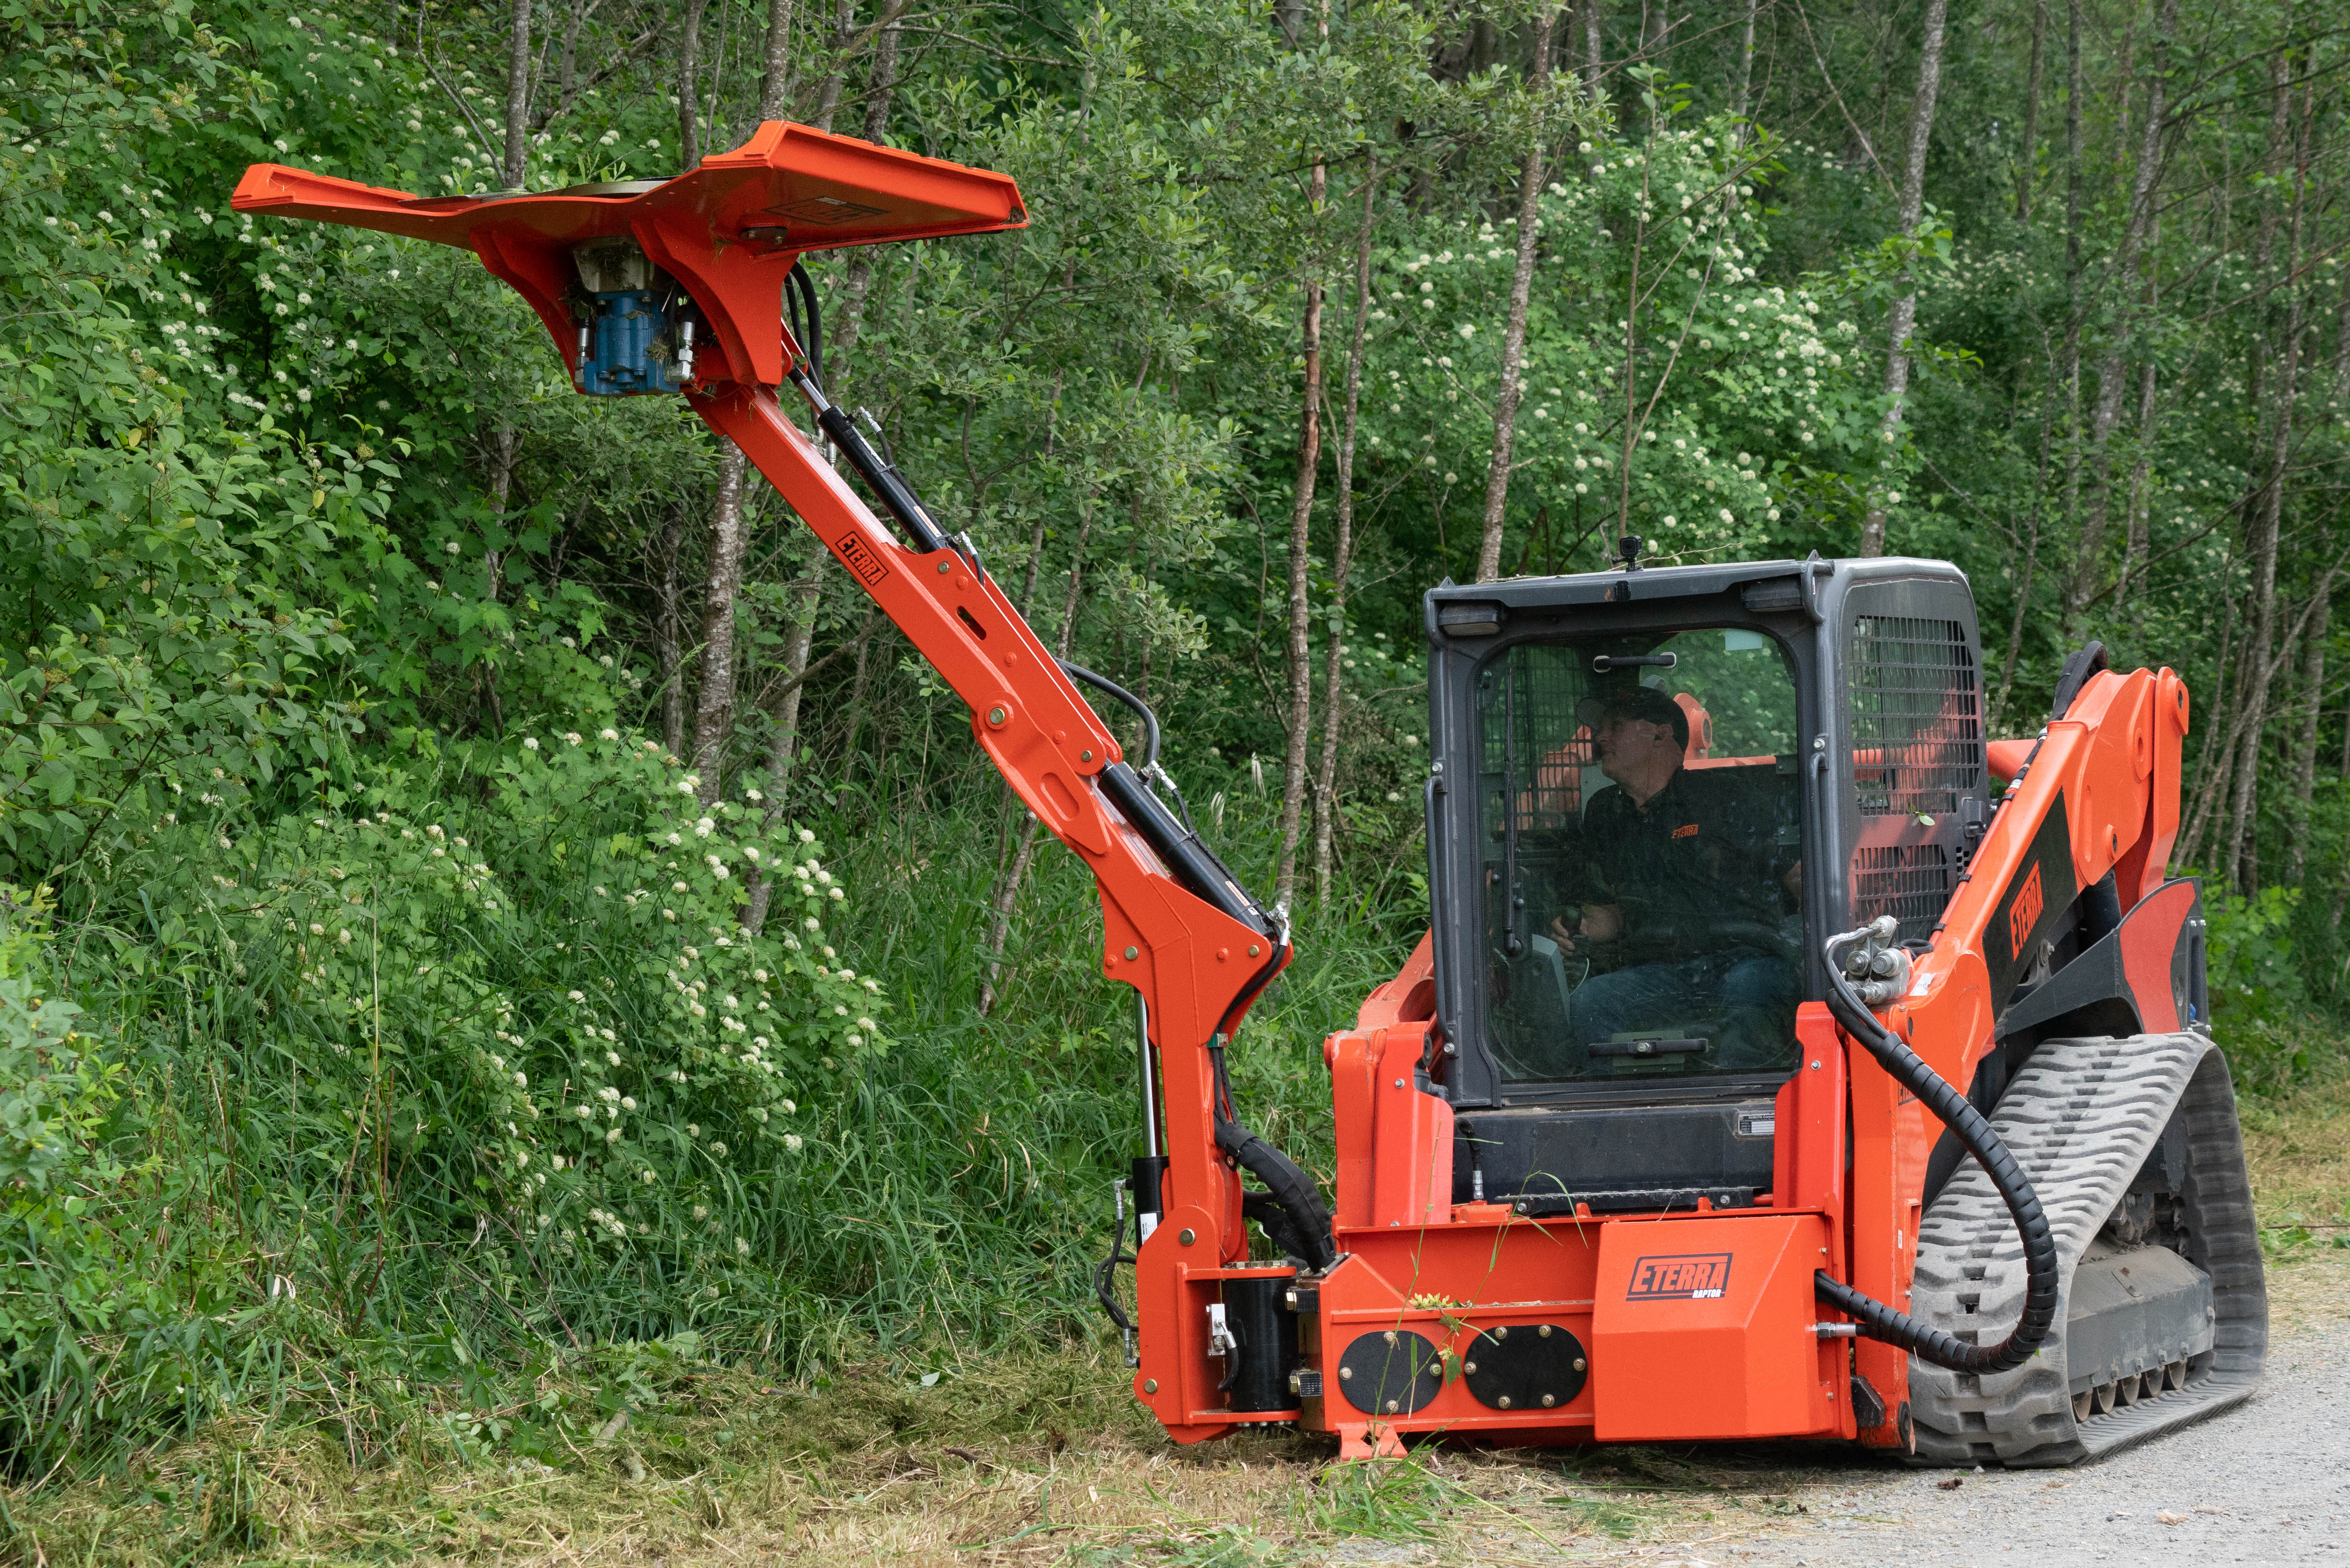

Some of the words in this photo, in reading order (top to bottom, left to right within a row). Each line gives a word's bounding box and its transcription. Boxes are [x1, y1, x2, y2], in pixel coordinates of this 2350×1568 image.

[836, 533, 885, 585] ETERRA
[2009, 864, 2044, 962] ETERRA
[1631, 1259, 1727, 1292] ETERRA
[1692, 1289, 1722, 1299] RAPTOR
